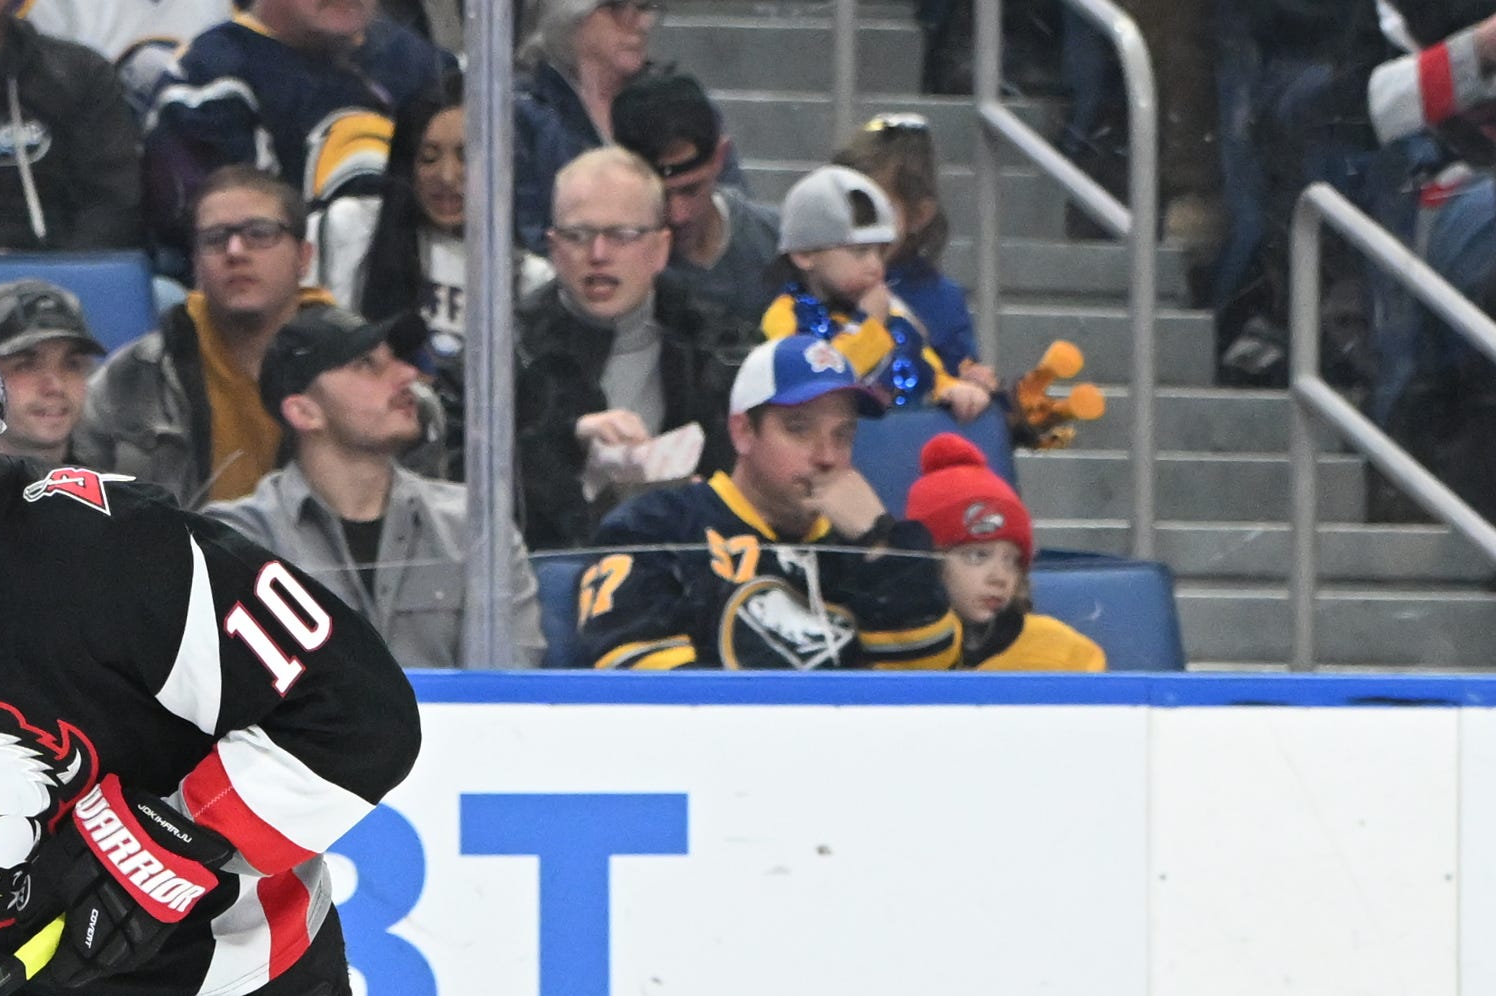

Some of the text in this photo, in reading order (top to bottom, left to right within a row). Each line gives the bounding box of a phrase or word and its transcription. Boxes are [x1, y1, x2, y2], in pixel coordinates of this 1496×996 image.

[223, 560, 333, 699] 10
[75, 783, 206, 913] WARRIOR
[137, 803, 193, 844] JOKIHARJU
[85, 908, 100, 949] COVERT
